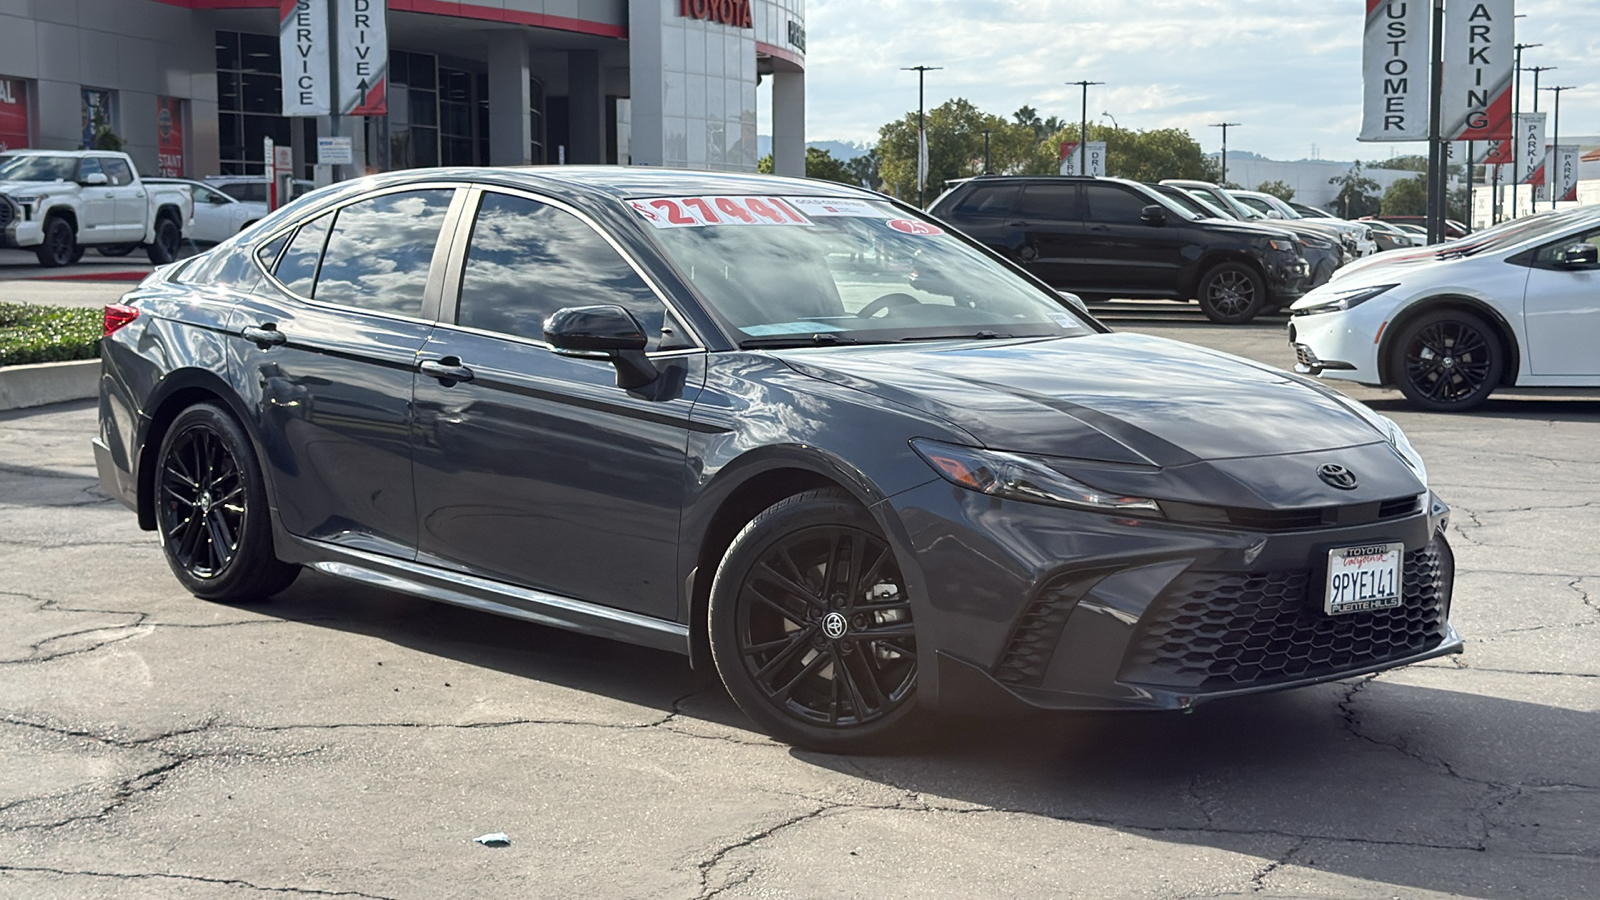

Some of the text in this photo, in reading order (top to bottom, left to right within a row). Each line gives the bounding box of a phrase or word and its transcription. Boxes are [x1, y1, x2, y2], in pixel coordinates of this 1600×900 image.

[680, 0, 753, 29] TOYOTA
[354, 0, 371, 76] DRIVE
[296, 0, 314, 106] SERVICE
[1383, 2, 1408, 131] USTOMER
[1465, 3, 1492, 129] ARKING
[158, 153, 182, 169] STANT
[1527, 124, 1537, 180] PARKING
[632, 197, 808, 224] $27441
[901, 220, 930, 234] 25
[1342, 554, 1388, 569] California
[1348, 546, 1386, 556] TOYOTA
[1331, 568, 1395, 604] 9PYE141
[1332, 598, 1398, 612] PUENTE HILLS
